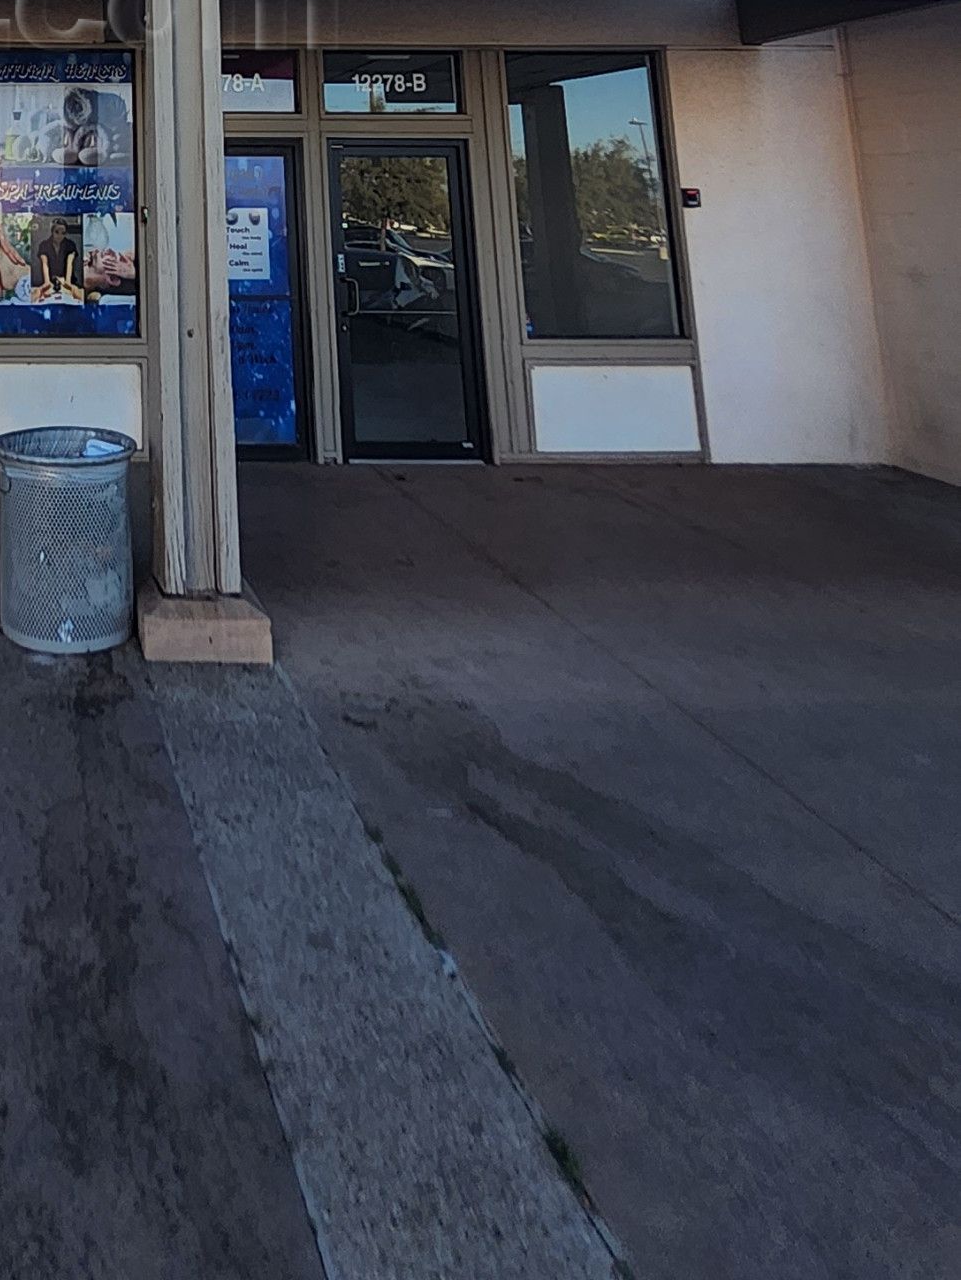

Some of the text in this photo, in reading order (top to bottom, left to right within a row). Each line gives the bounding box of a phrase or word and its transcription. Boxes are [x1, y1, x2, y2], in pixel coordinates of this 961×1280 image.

[222, 74, 265, 92] 78-A
[351, 73, 426, 92] 12278-B
[33, 183, 121, 201] TREATMENTS
[226, 226, 251, 234] Touch
[228, 259, 250, 267] Calm
